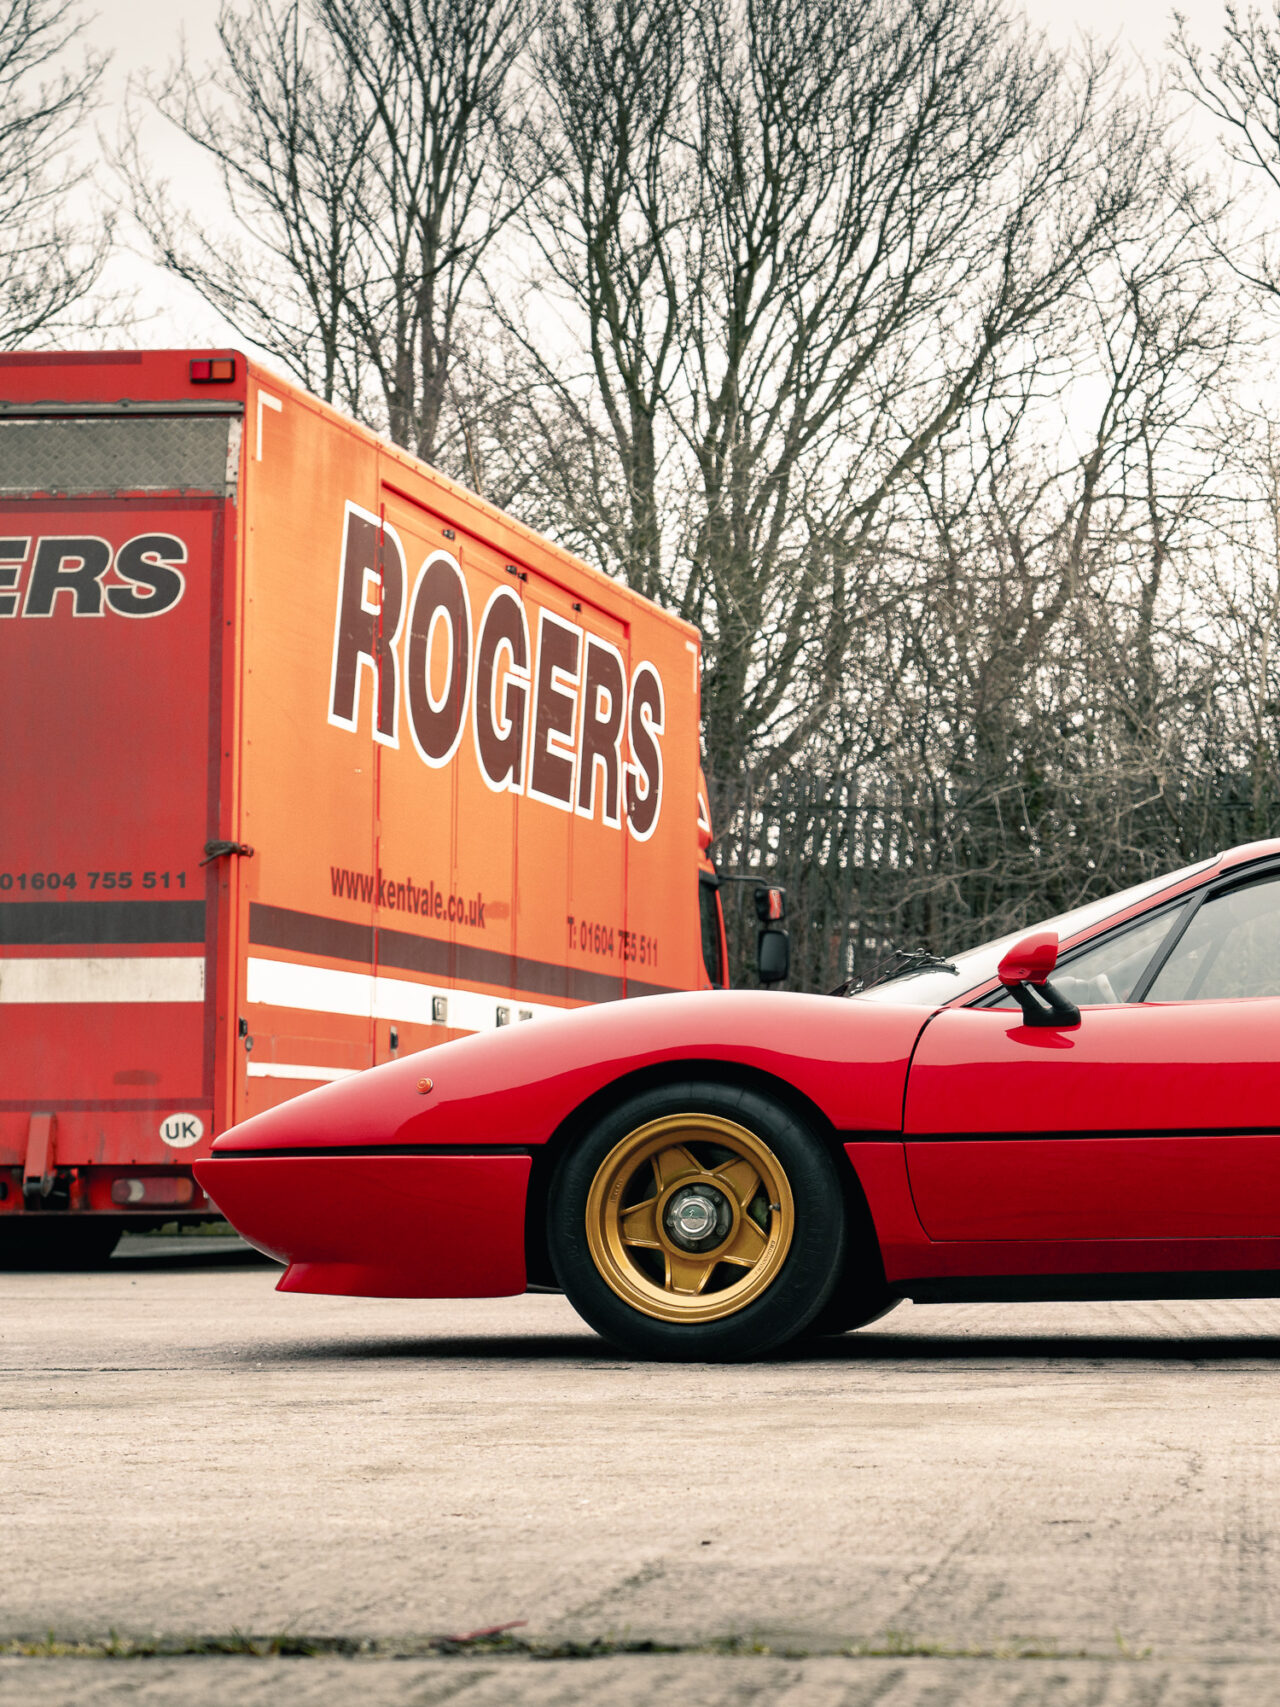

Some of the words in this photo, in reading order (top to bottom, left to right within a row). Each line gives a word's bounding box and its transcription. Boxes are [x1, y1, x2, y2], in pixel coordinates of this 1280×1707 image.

[327, 499, 665, 842] ROGERS
[0, 872, 77, 890] 01604
[87, 872, 133, 889] 755
[142, 872, 186, 888] 511
[330, 866, 486, 929] www.kentvale.co.uk
[567, 915, 577, 950] T:
[580, 920, 614, 958] 01604
[618, 929, 637, 962] 755
[640, 935, 658, 967] 511
[165, 1121, 197, 1140] UK
